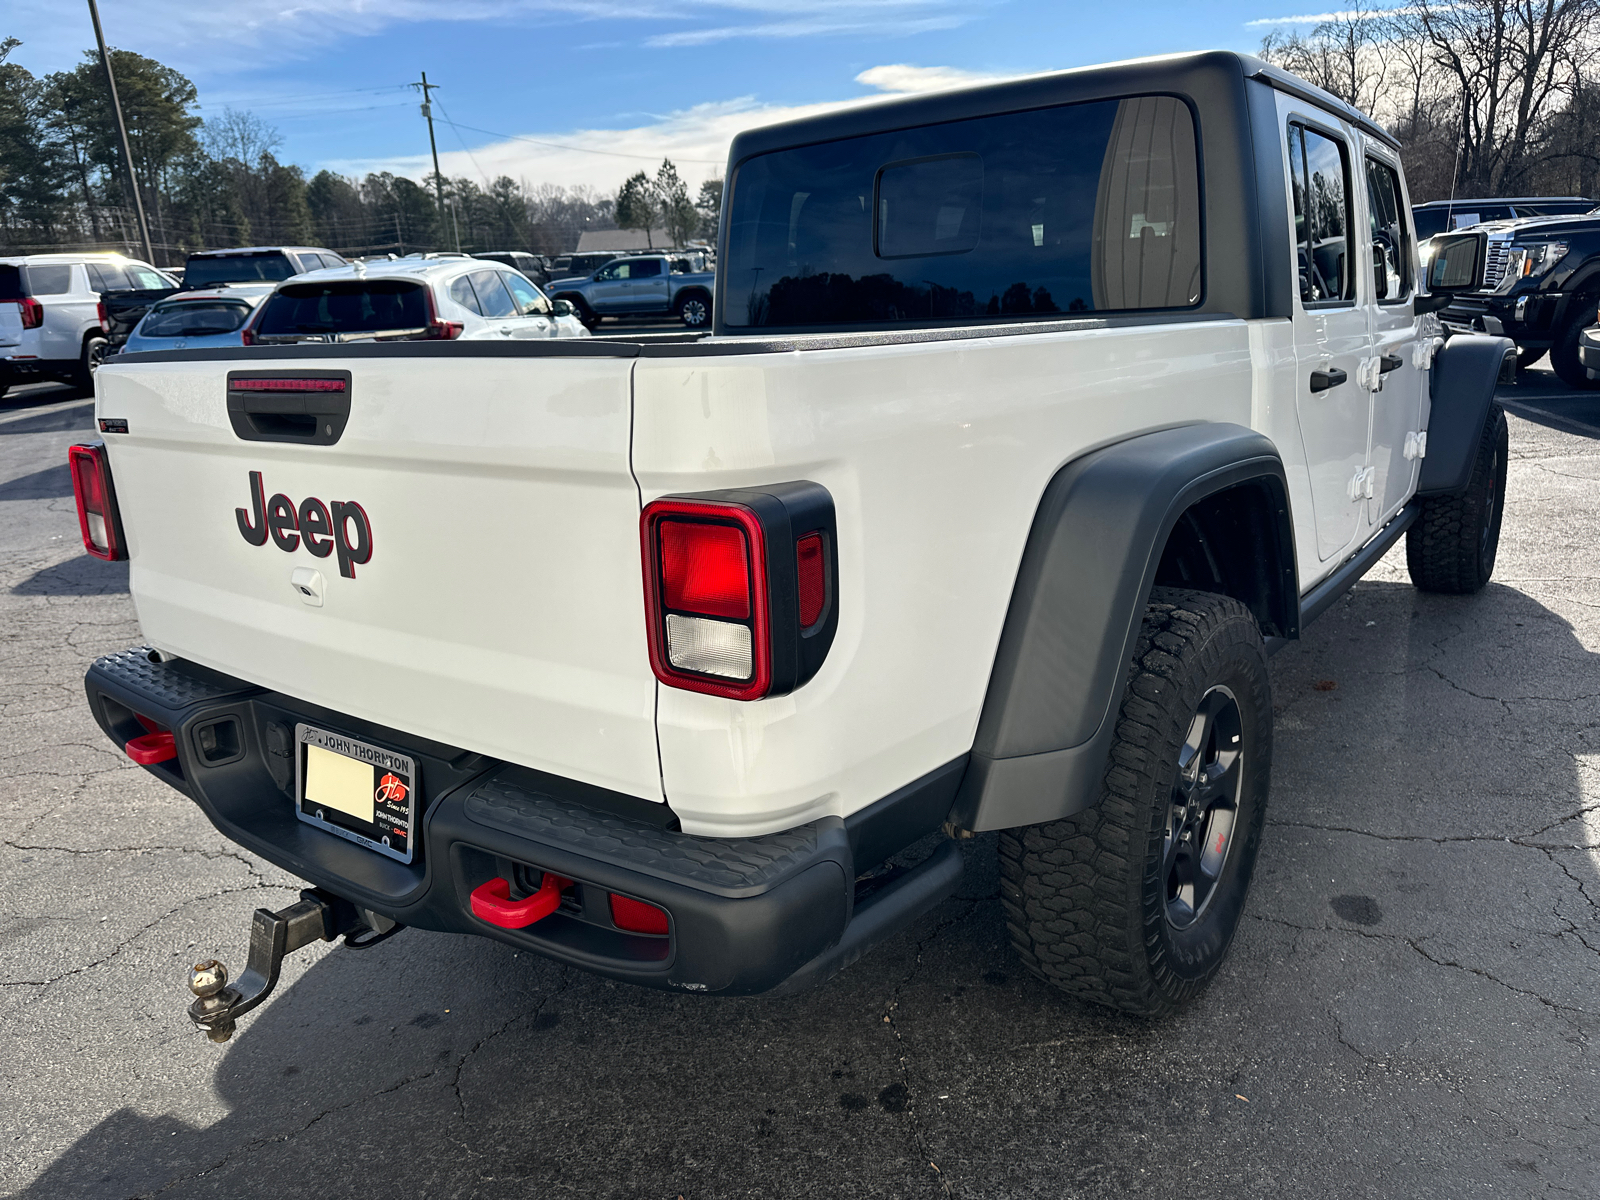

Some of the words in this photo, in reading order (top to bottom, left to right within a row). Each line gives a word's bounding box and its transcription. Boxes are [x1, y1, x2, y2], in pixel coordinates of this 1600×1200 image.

[235, 470, 373, 579] Jeep
[324, 735, 351, 753] JOHN
[353, 744, 409, 773] THORNTON
[375, 810, 388, 820] JOHN
[393, 827, 407, 838] GMC
[356, 835, 373, 848] GMC
